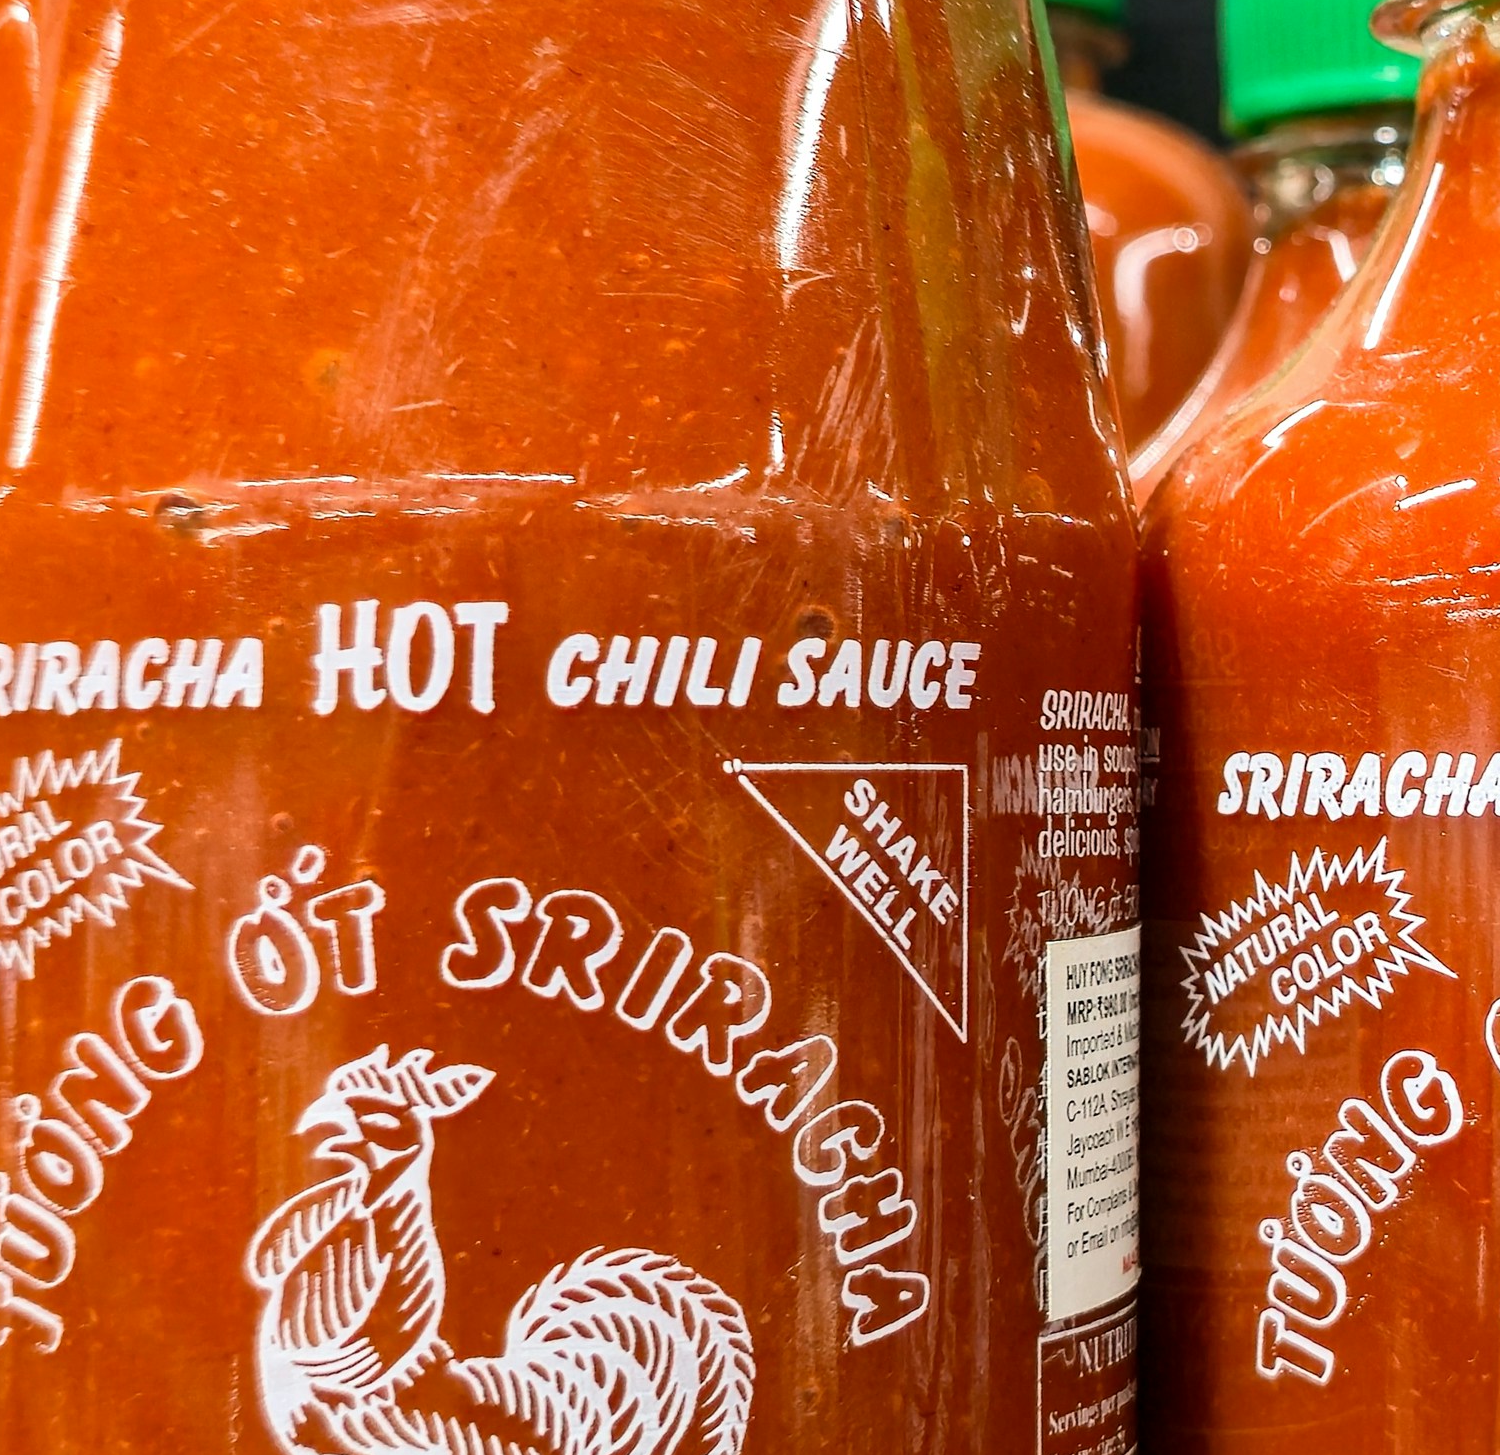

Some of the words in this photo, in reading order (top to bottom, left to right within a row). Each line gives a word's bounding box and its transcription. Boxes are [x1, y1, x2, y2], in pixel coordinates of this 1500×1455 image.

[312, 599, 509, 715] HOT
[546, 632, 762, 709] CHILI
[777, 637, 981, 710] SAUCE
[1038, 743, 1077, 772] use
[0, 820, 120, 926] COLOR
[824, 824, 920, 949] WELL
[844, 778, 959, 926] SHAKE
[1205, 891, 1340, 1006] NATURAL
[1269, 914, 1387, 1006] COLOR
[441, 877, 930, 1347] SRIRACHA
[1066, 1064, 1110, 1089] SABLOK
